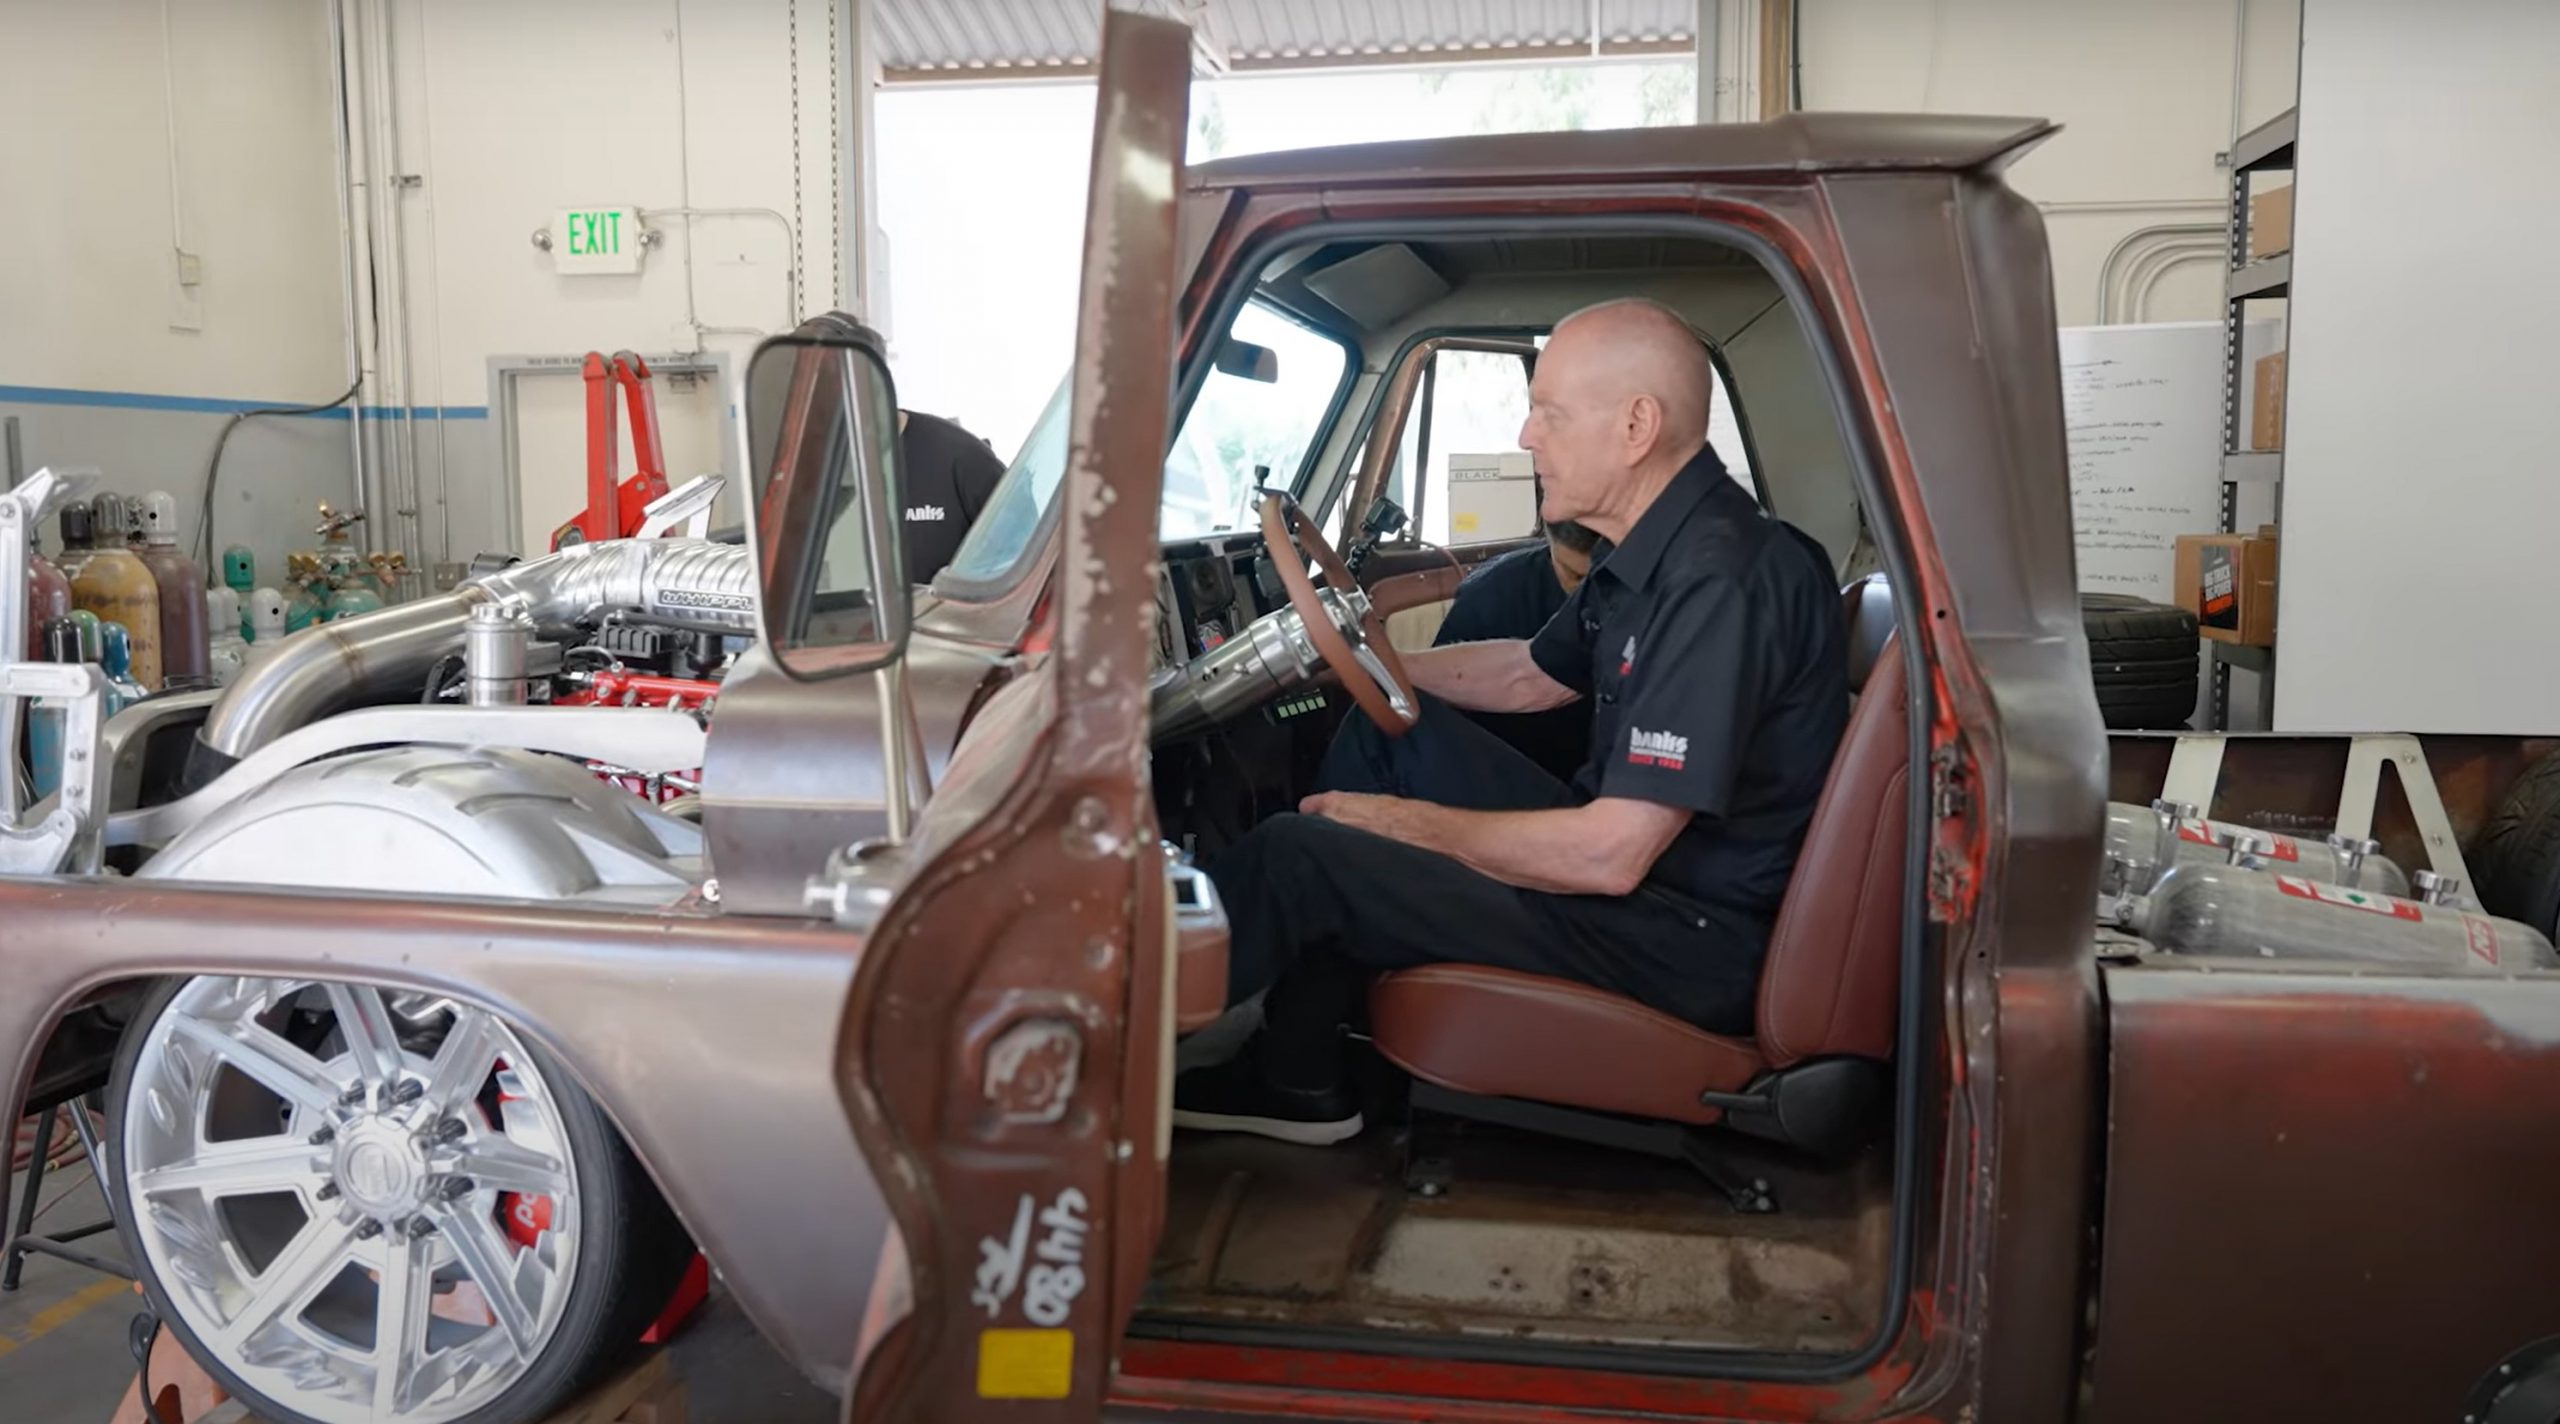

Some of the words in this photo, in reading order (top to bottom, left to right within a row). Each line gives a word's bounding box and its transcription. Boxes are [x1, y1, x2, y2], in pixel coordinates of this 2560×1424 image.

[568, 212, 621, 254] EXIT
[904, 504, 945, 521] anks
[662, 591, 753, 609] WHIPPL
